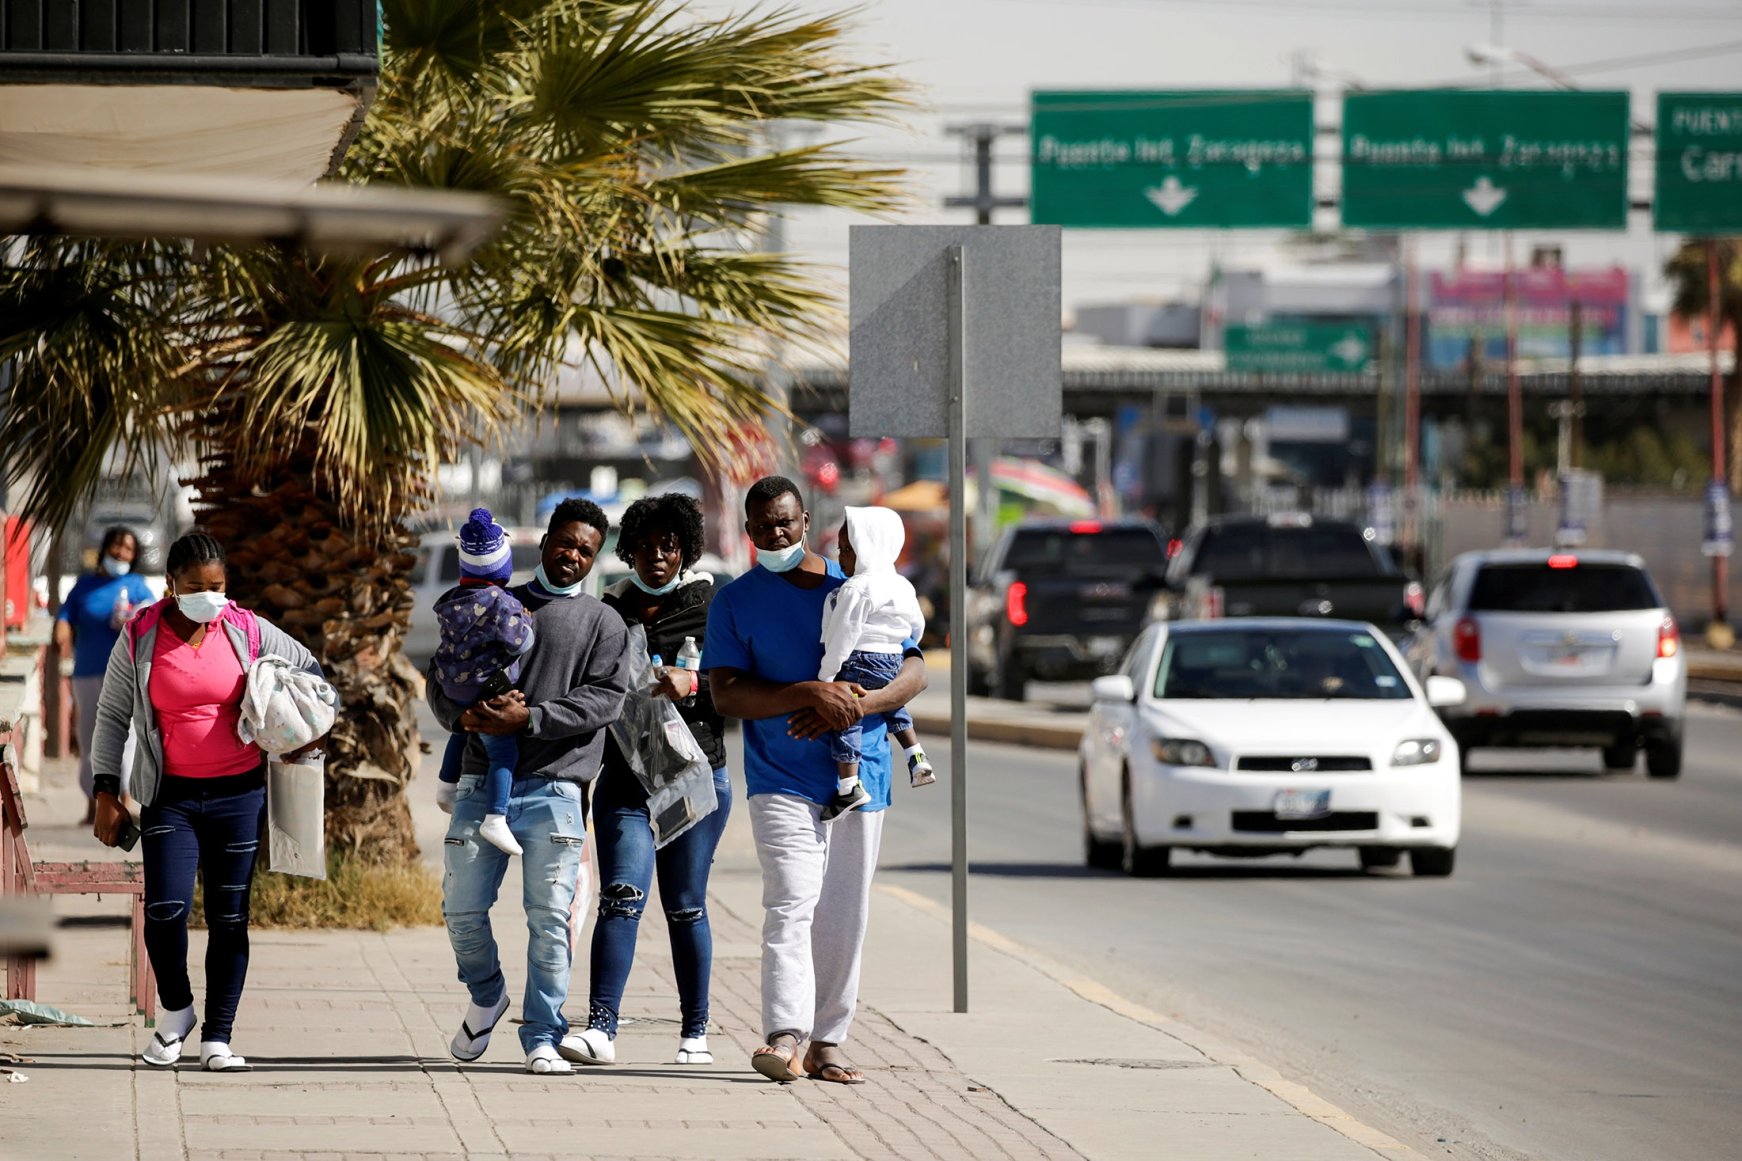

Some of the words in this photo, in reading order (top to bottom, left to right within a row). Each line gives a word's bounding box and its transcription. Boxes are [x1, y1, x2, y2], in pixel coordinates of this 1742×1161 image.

[1039, 135, 1131, 166] Puente
[1188, 135, 1305, 171] Zaragoza
[1350, 135, 1440, 166] Puente
[1498, 135, 1619, 176] Zaragoza
